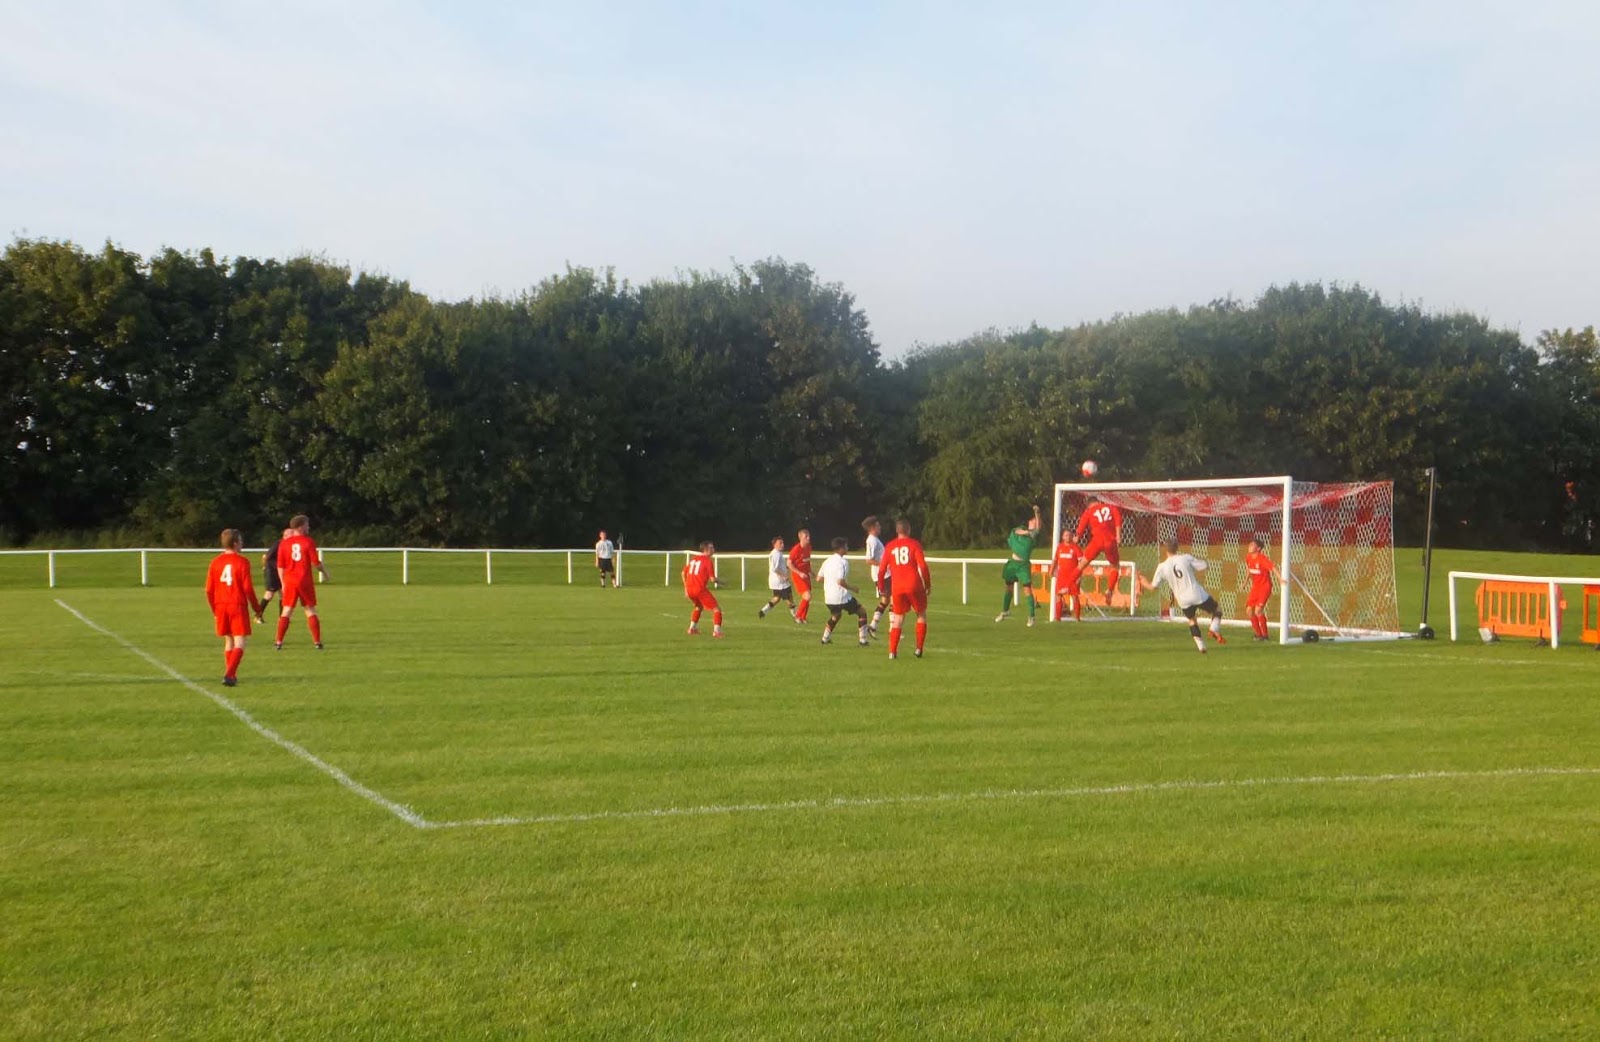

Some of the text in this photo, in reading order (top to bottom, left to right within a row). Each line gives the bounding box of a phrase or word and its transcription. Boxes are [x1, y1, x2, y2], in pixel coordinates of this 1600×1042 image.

[1093, 506, 1112, 523] 12
[291, 543, 302, 561] 8
[891, 546, 909, 565] 18
[220, 564, 233, 587] 4
[689, 560, 702, 576] 11
[1173, 563, 1183, 579] 6
